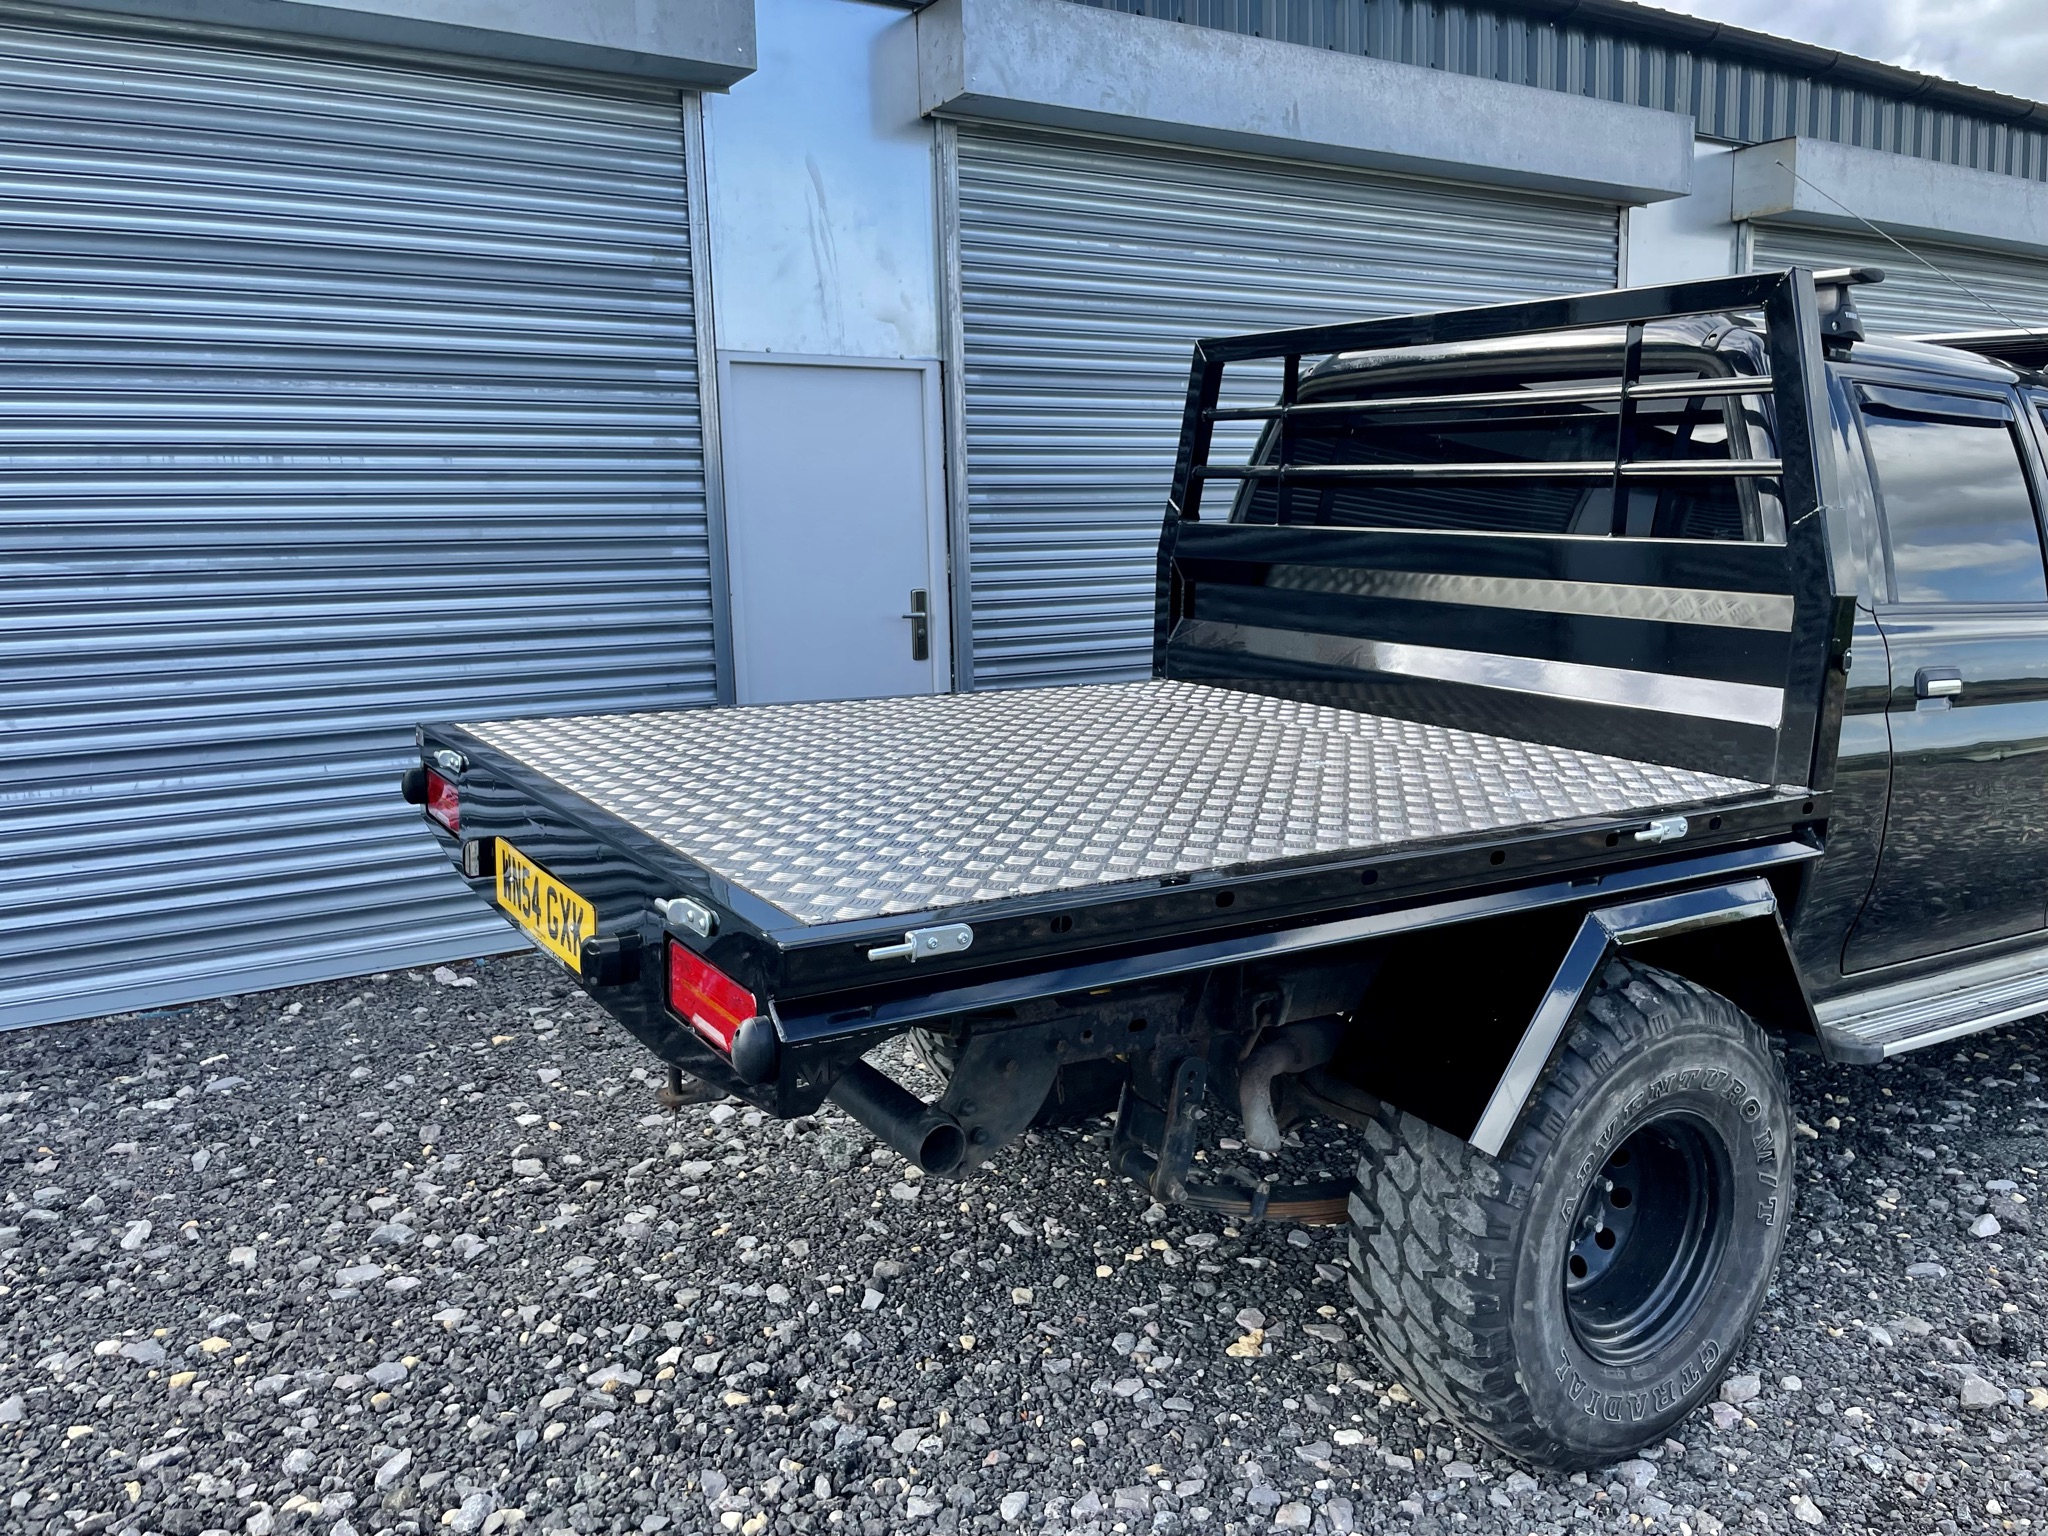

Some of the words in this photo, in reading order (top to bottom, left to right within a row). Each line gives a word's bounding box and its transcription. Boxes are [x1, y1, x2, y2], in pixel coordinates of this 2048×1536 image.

[502, 849, 542, 928] WN54
[546, 885, 584, 957] GXK
[1561, 1067, 1762, 1227] ADVENTURO
[1753, 1127, 1778, 1226] M/T
